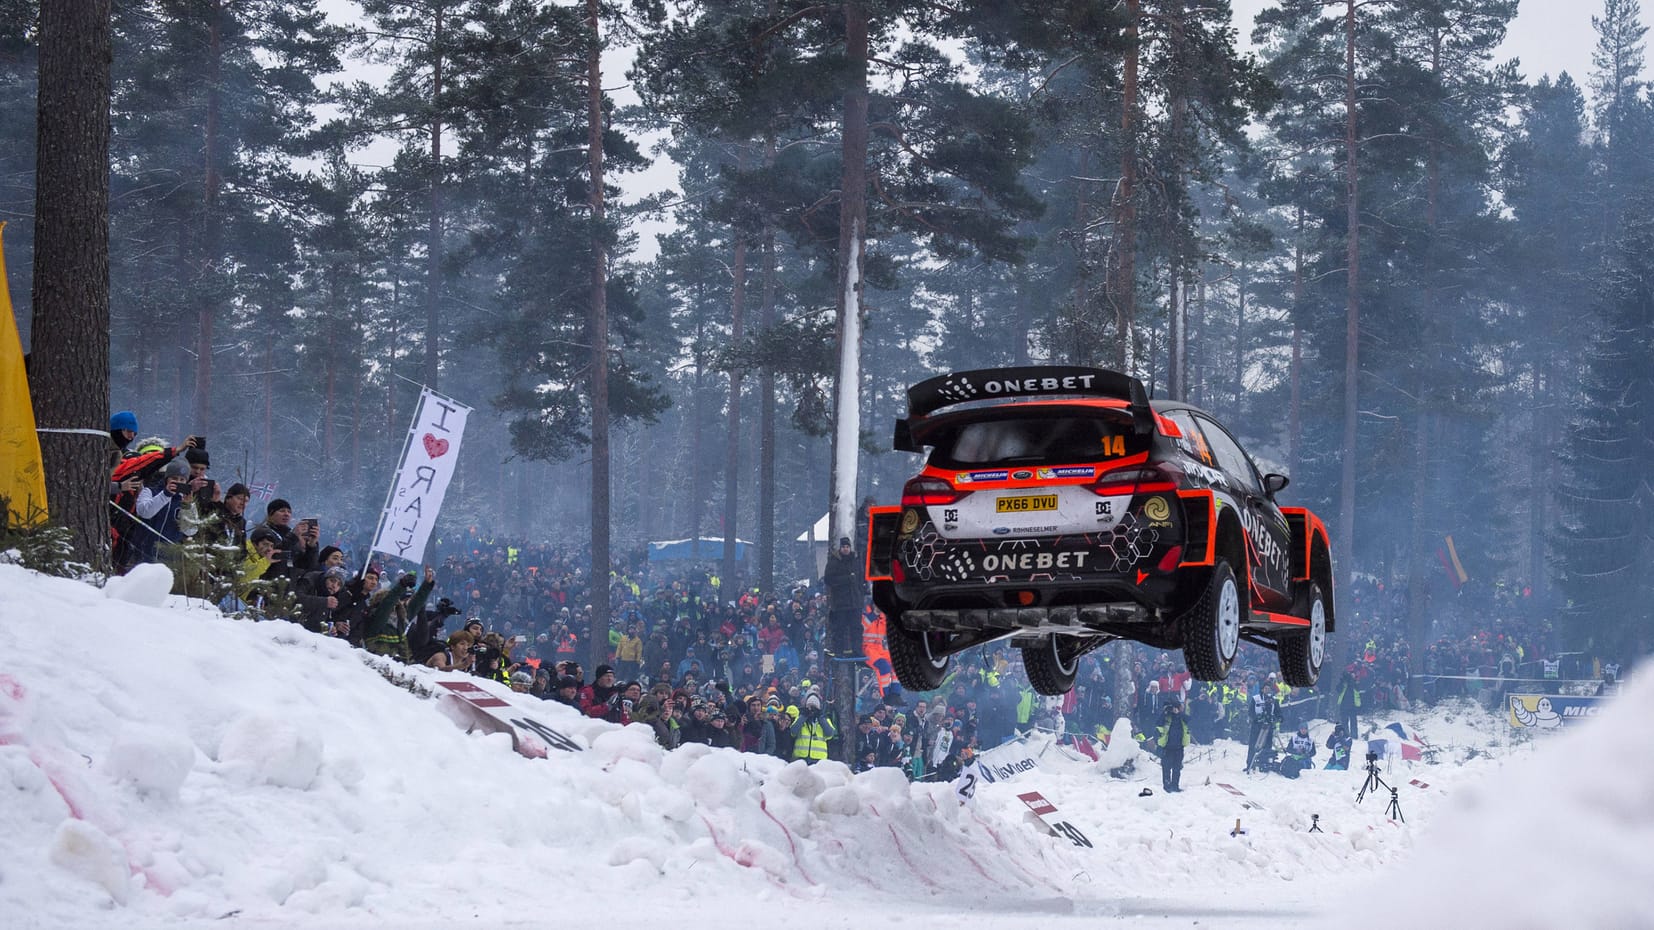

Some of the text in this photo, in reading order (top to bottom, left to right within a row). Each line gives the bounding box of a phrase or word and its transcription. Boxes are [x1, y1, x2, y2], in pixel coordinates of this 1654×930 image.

[984, 374, 1096, 394] ONEBET
[1100, 434, 1127, 457] 14
[973, 471, 1008, 479] MICHELIN
[1056, 468, 1095, 476] MICHELIN
[998, 497, 1057, 511] PX66 DVU
[1242, 508, 1282, 571] ONEBET
[982, 551, 1090, 572] ONEBET
[1052, 821, 1094, 849] 30
